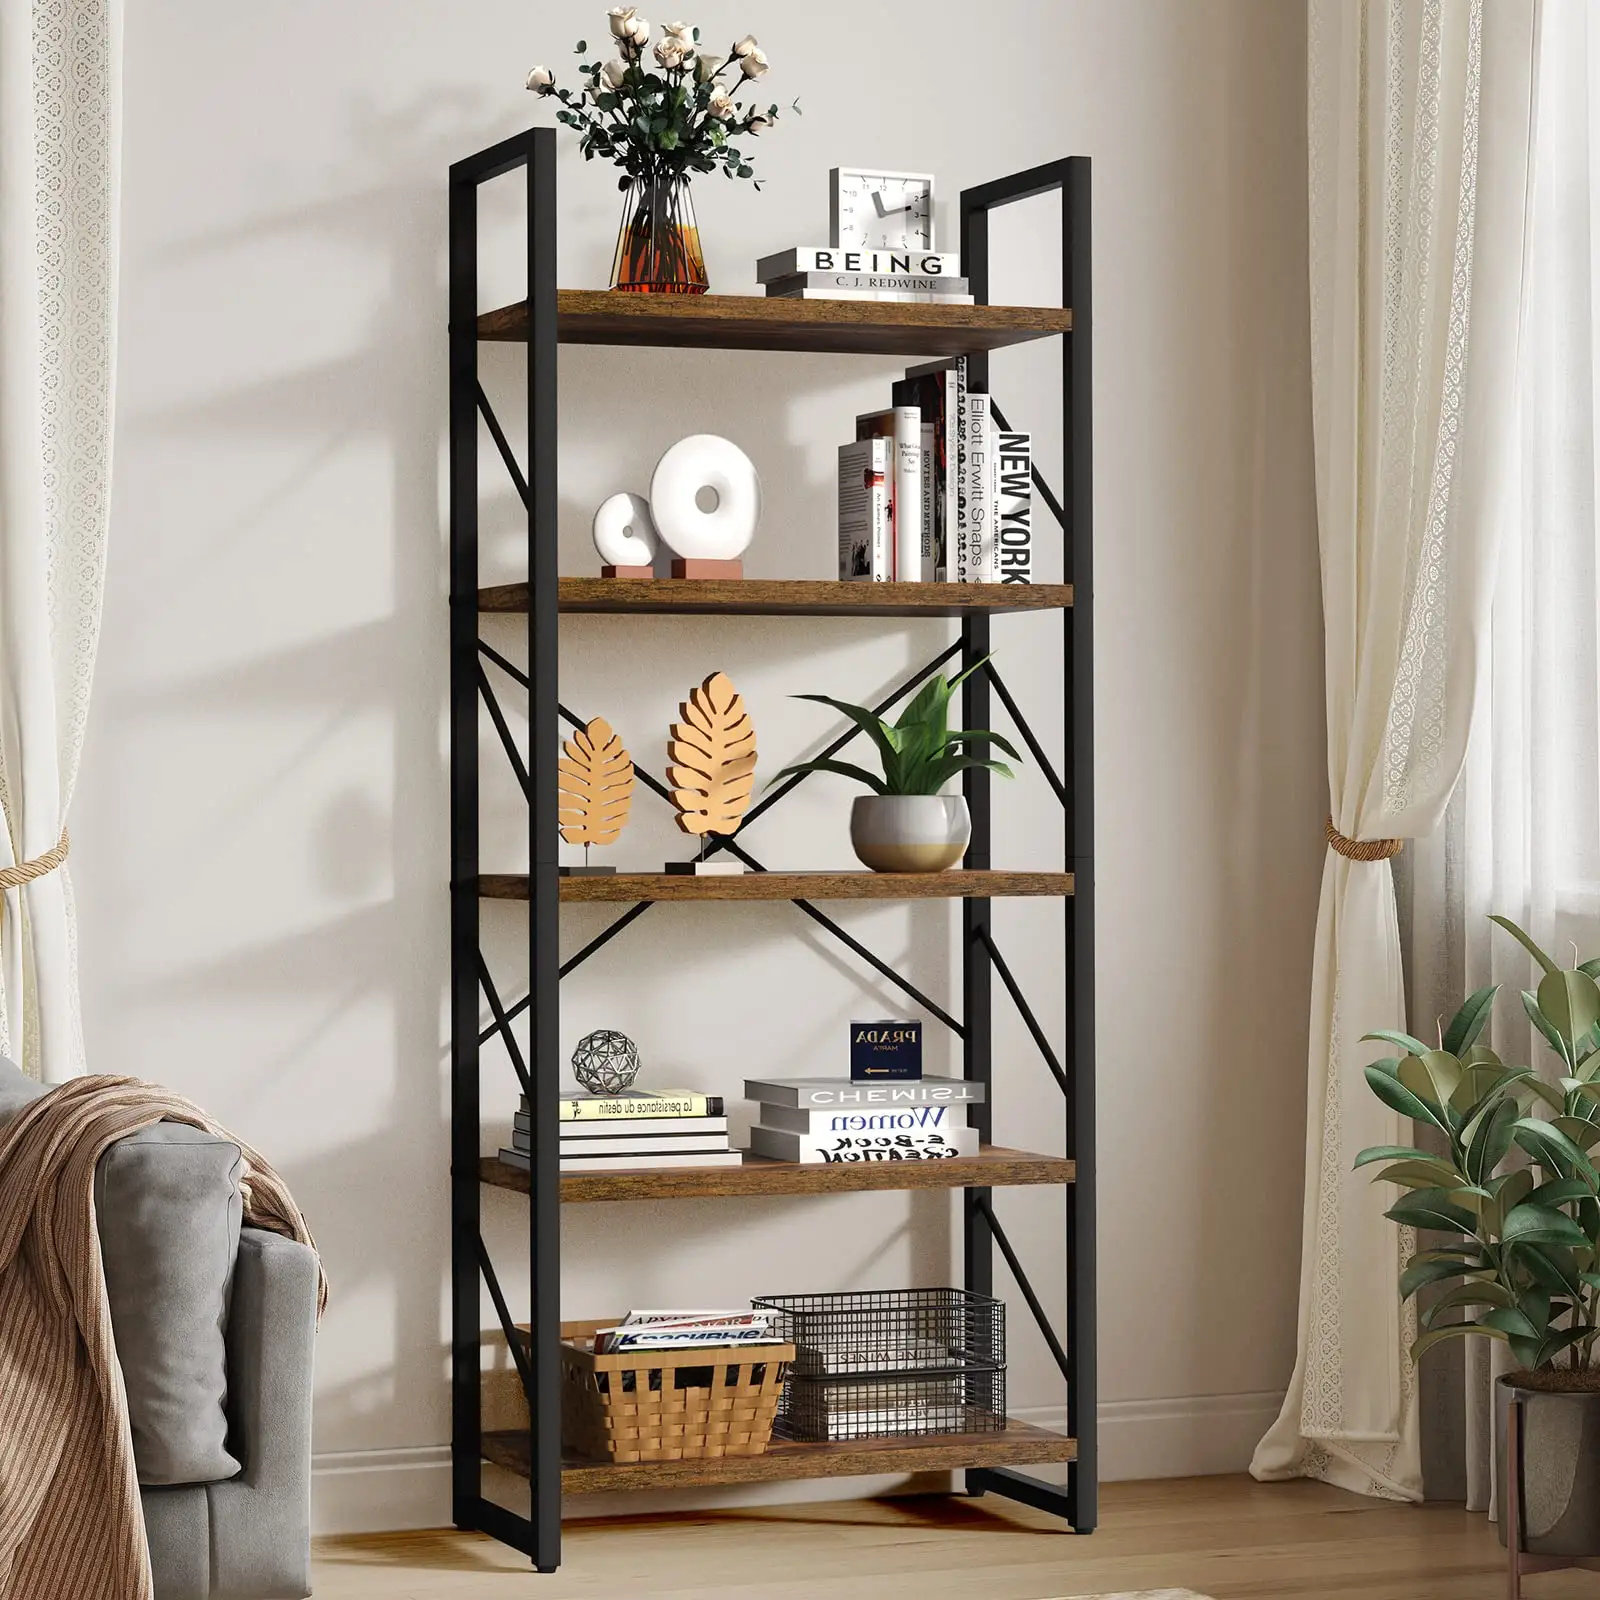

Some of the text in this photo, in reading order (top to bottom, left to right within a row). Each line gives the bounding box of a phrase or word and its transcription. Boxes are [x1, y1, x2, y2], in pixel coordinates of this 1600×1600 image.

[815, 251, 942, 275] BEING
[836, 277, 937, 290] C. J. REDWINE
[969, 399, 984, 567] Elliott Erwitt Snaps
[1000, 434, 1031, 584] NEW YORK
